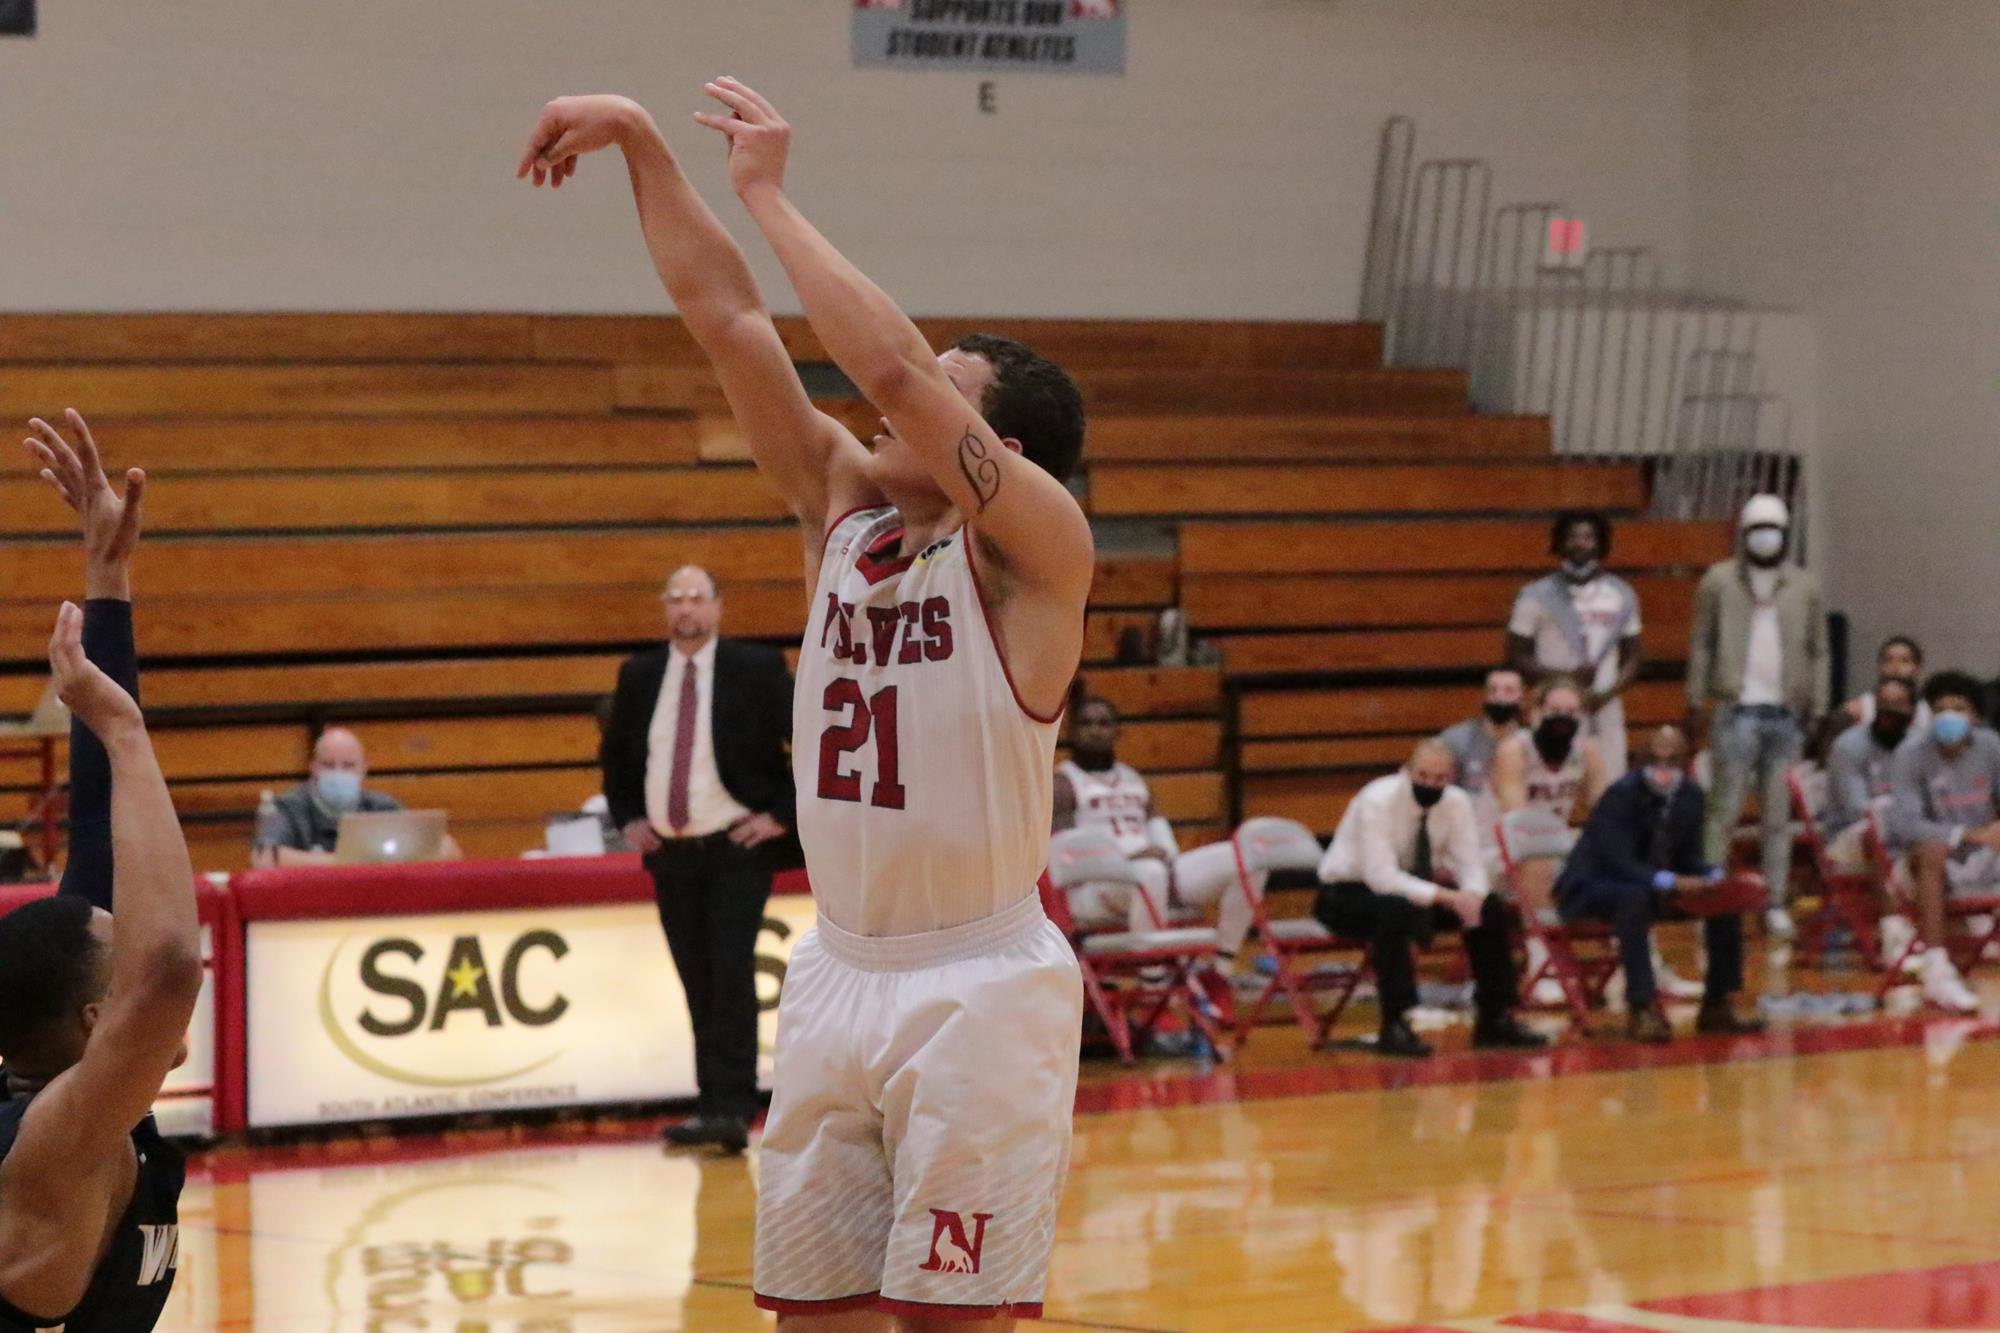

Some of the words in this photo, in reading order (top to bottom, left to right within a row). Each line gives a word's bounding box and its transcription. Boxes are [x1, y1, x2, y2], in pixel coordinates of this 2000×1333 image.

[886, 27, 977, 58] STUDENT
[981, 32, 1077, 63] ATHLETES
[978, 81, 996, 113] E
[817, 677, 906, 810] 21
[356, 928, 570, 1037] SAC
[918, 1208, 994, 1274] N
